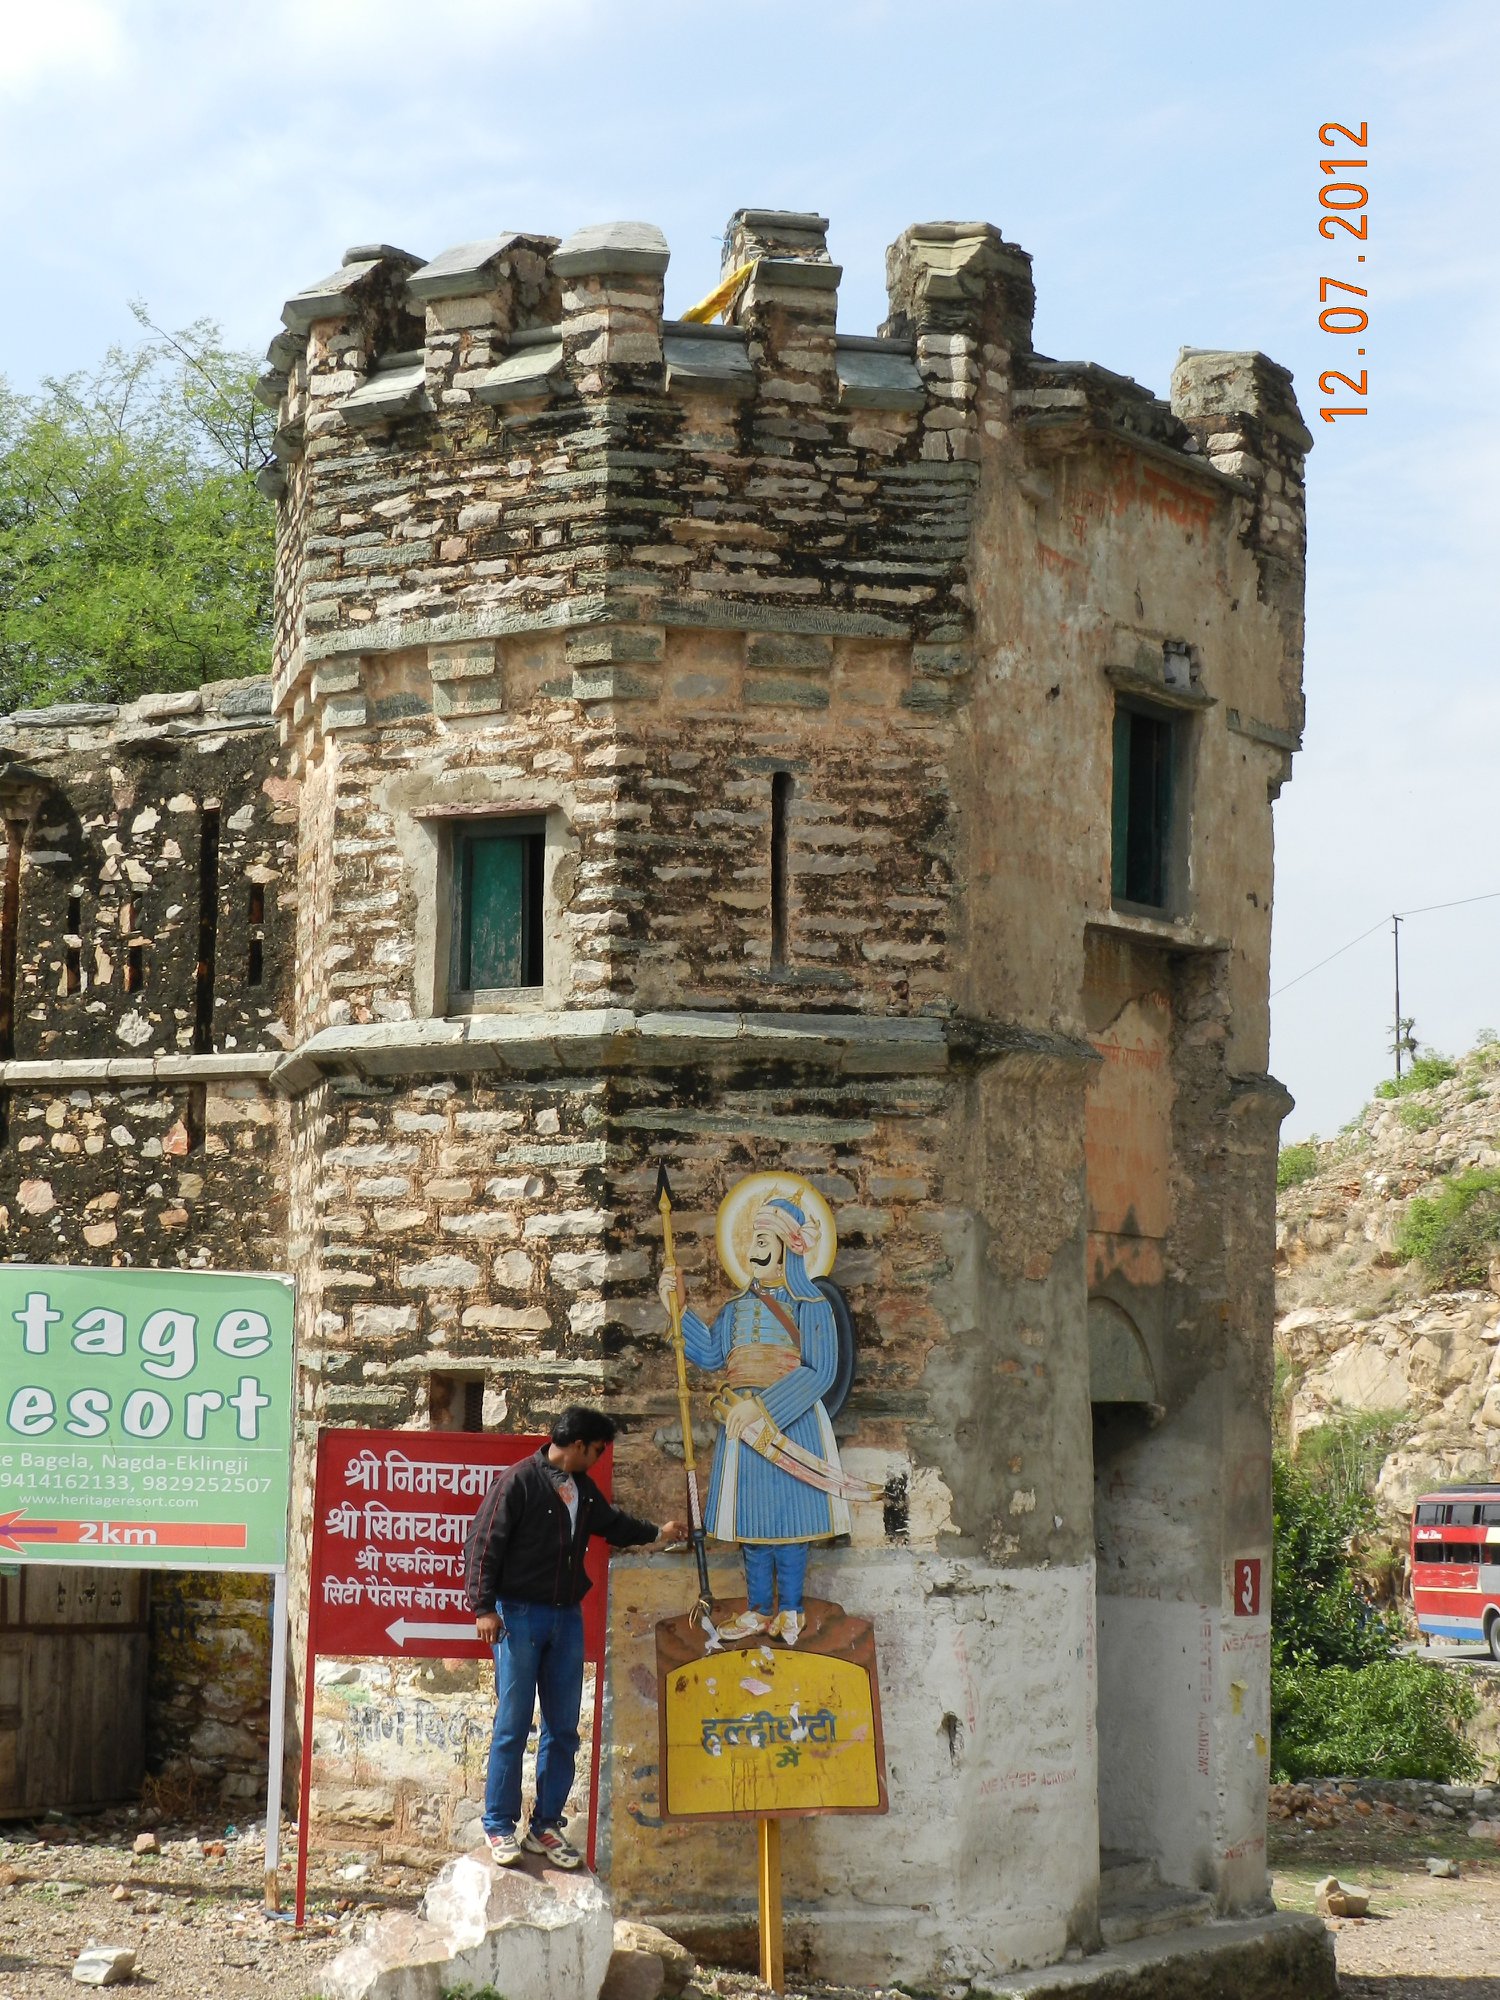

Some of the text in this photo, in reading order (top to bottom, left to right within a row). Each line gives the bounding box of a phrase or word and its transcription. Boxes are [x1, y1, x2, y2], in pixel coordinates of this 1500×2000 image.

[12, 1292, 272, 1379] tage
[6, 1377, 271, 1439] esort
[21, 1452, 94, 1471] Bagela,
[102, 1454, 249, 1475] Nagda-Eklingji
[344, 1449, 510, 1496] श्री निमच मा
[0, 1472, 272, 1494] 9414162133, 9829252507
[19, 1492, 199, 1508] www.heritageresort.com
[78, 1522, 157, 1545] 2km
[325, 1501, 476, 1544] श्री खिमच मा
[355, 1545, 383, 1573] श्री
[385, 1546, 457, 1577] एकलिंग
[322, 1575, 365, 1606] सिटी
[366, 1575, 416, 1608] पैलेस
[701, 1708, 838, 1757] हल्दीघाटी
[775, 1744, 803, 1768] में
